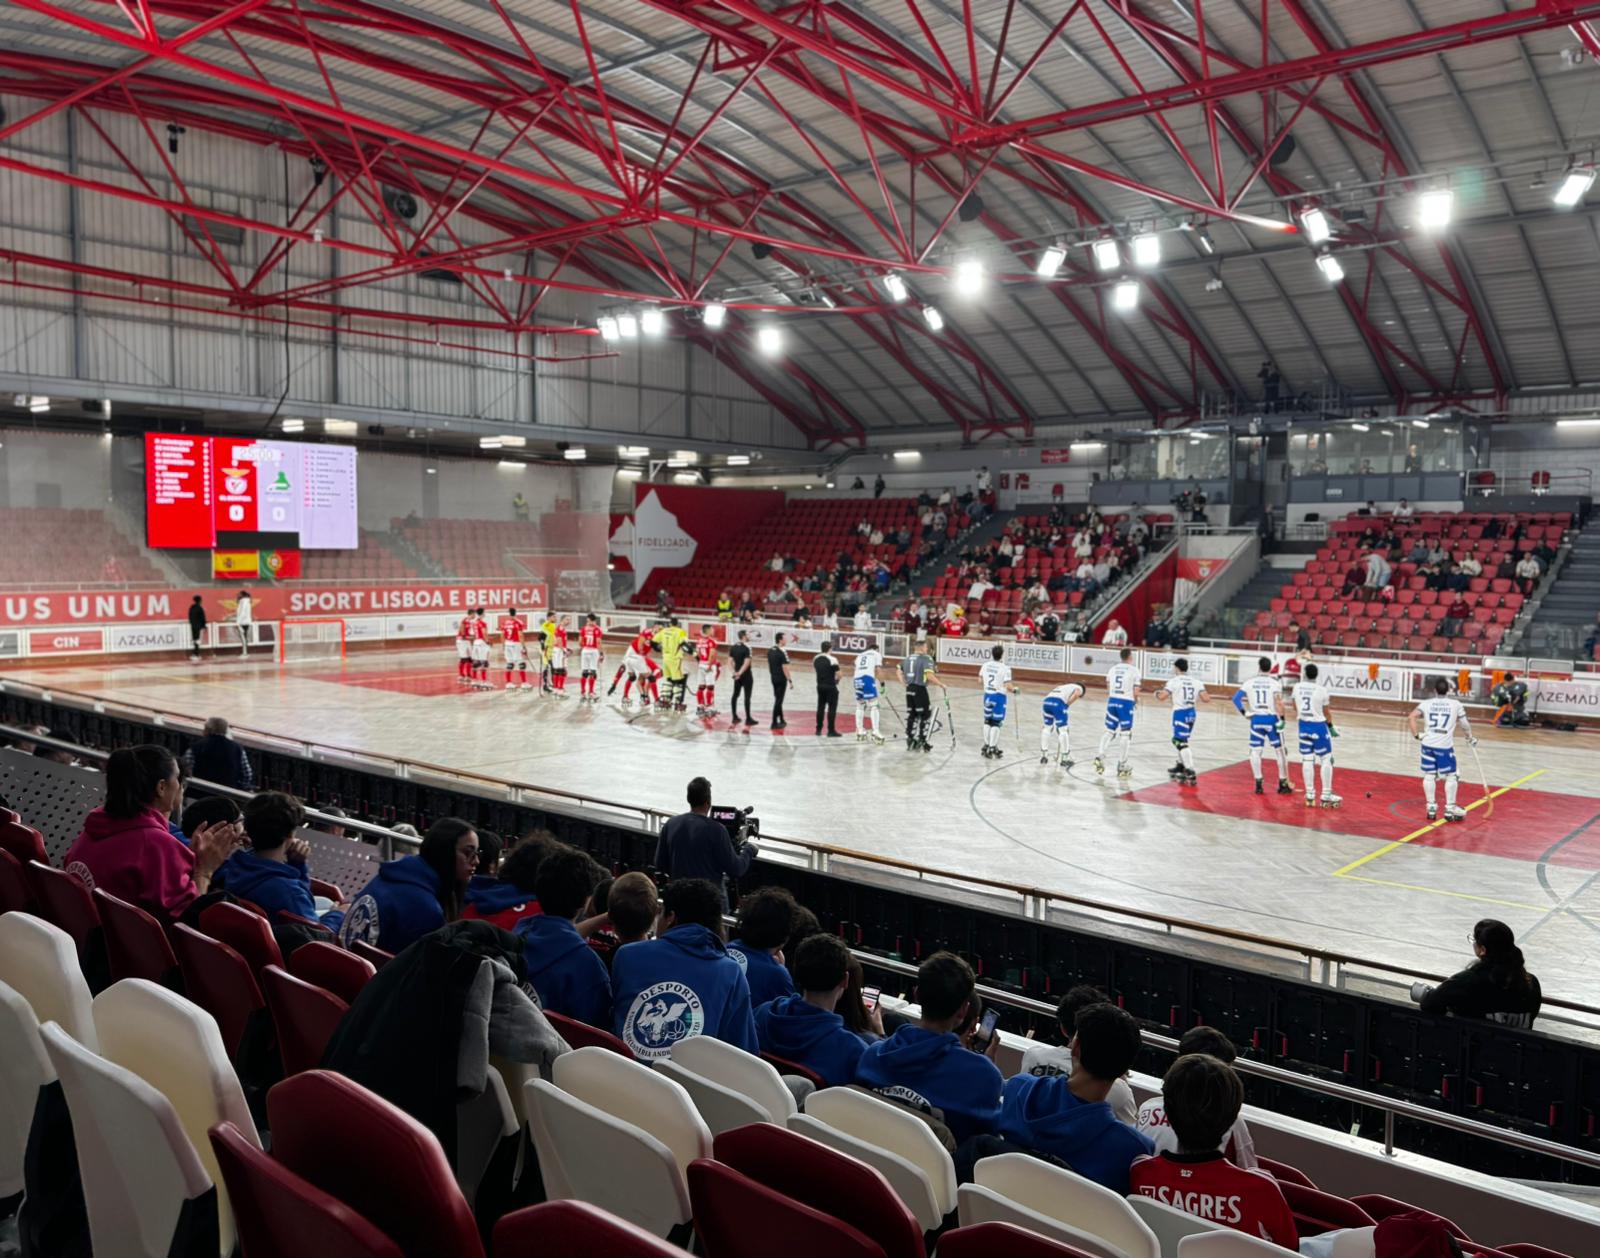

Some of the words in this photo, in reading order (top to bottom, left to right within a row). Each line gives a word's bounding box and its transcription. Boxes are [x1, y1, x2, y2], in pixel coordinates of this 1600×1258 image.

[638, 537, 690, 548] FIDELIDADE
[5, 597, 52, 621] US
[68, 594, 171, 619] UNUM
[290, 591, 365, 612] SPORT
[371, 590, 444, 609] LISBOA
[450, 589, 460, 607] E
[465, 588, 542, 606] BENFICA
[53, 636, 80, 648] CIN
[118, 633, 175, 647] AZEMAD
[946, 647, 992, 660] AZEMAD
[988, 674, 995, 688] 2
[1115, 675, 1123, 690] 5
[1322, 675, 1393, 692] AZEMAD
[1182, 686, 1195, 701] 13
[1255, 690, 1267, 704] 11
[1537, 691, 1599, 706] AZEMAD
[1301, 696, 1311, 712] 3
[1429, 713, 1451, 729] 57
[640, 983, 700, 1010] DESPORTO
[1158, 1185, 1242, 1224] SAGRES
